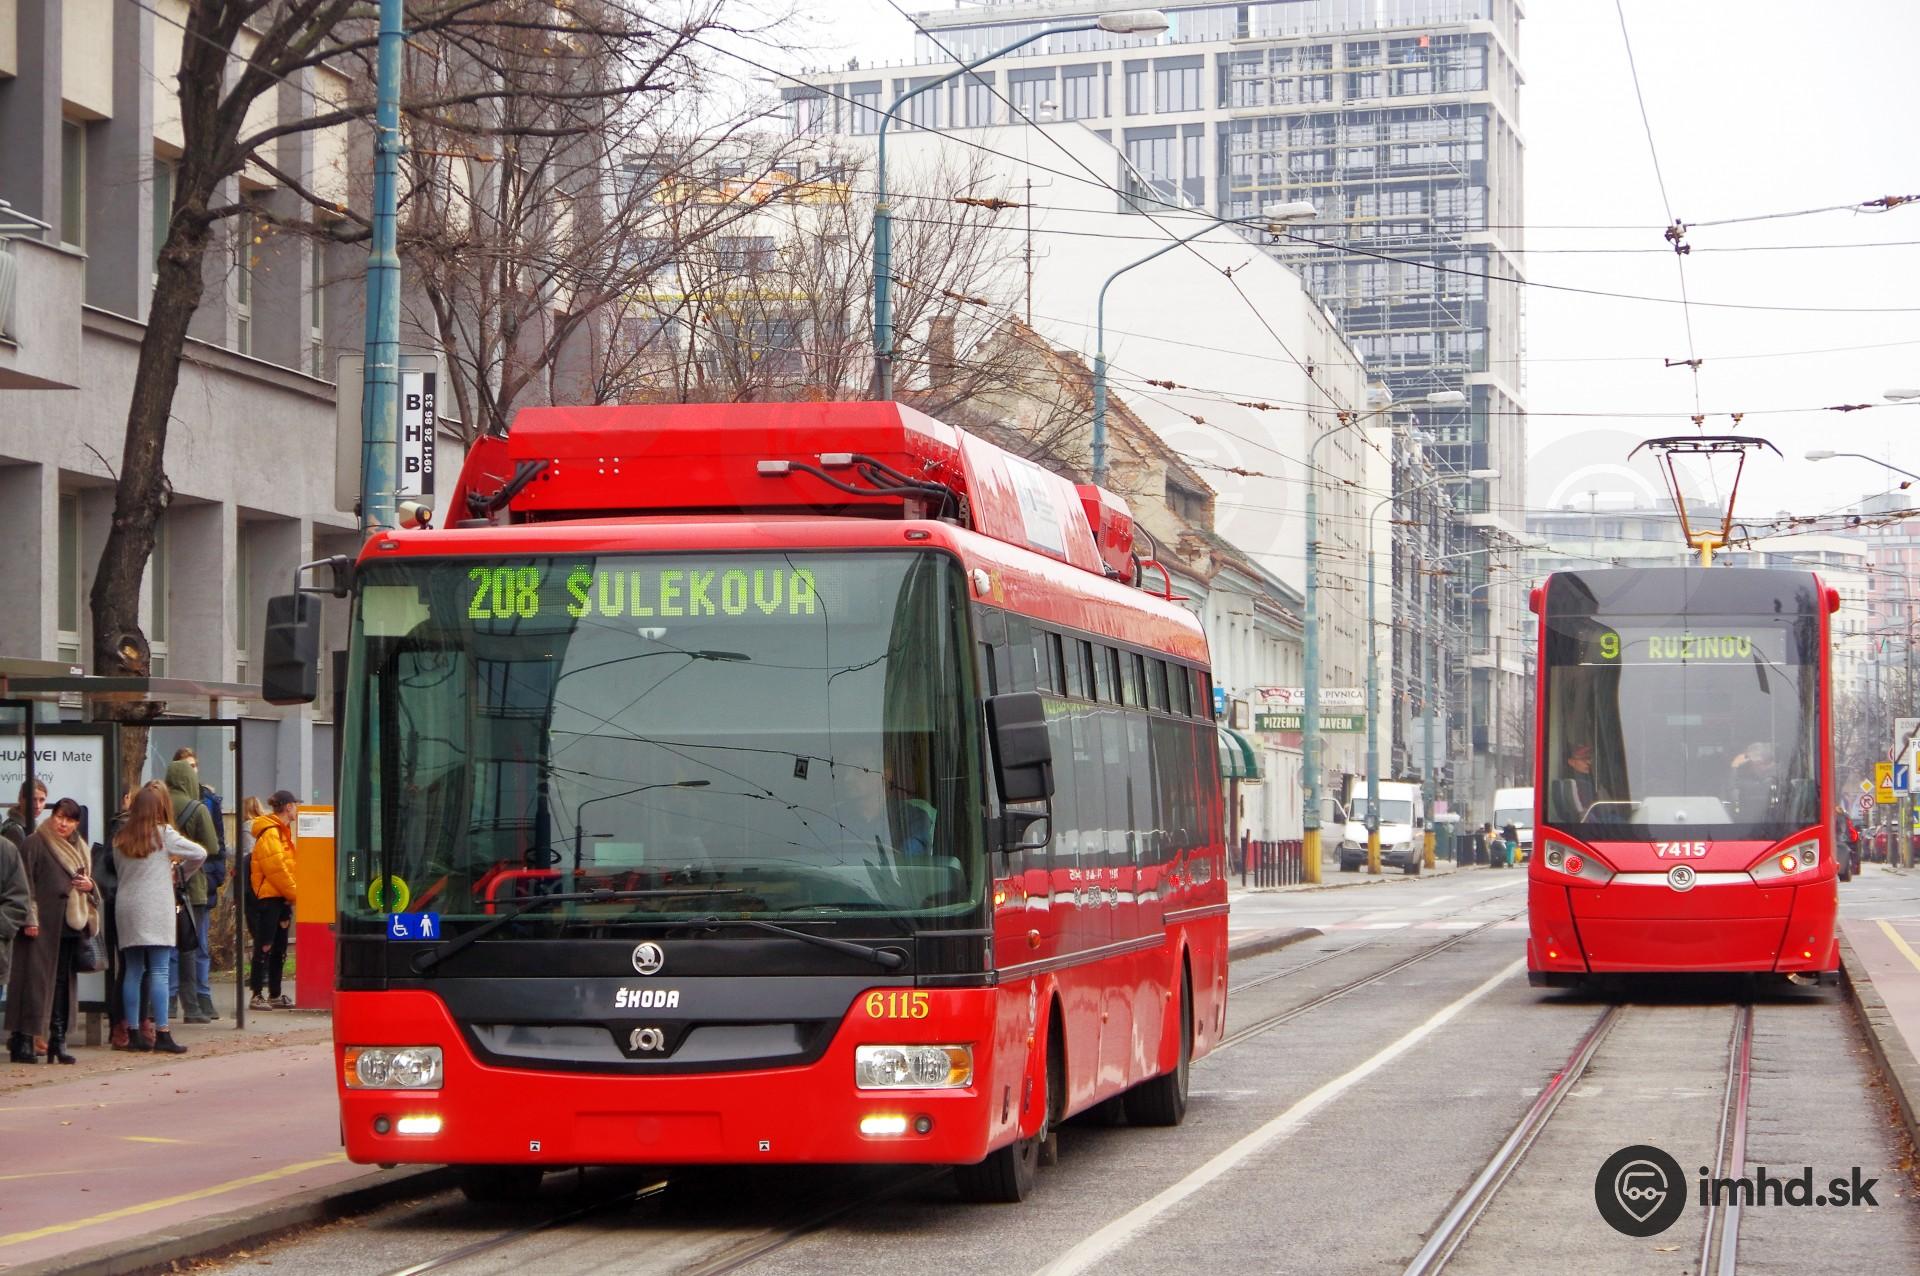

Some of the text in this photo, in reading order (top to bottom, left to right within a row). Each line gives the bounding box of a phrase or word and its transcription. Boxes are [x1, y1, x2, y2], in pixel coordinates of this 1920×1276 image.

[424, 393, 433, 473] 0911 26 86 33
[468, 563, 817, 620] 208 ŠULEKOVA
[1600, 632, 1620, 660] 9
[1325, 690, 1363, 699] PIVNICA
[1263, 716, 1301, 729] PIZZERIA
[62, 751, 93, 762] Mate
[1656, 841, 1706, 857] 7415
[614, 987, 680, 1009] ŠKODA
[865, 991, 930, 1019] 6115
